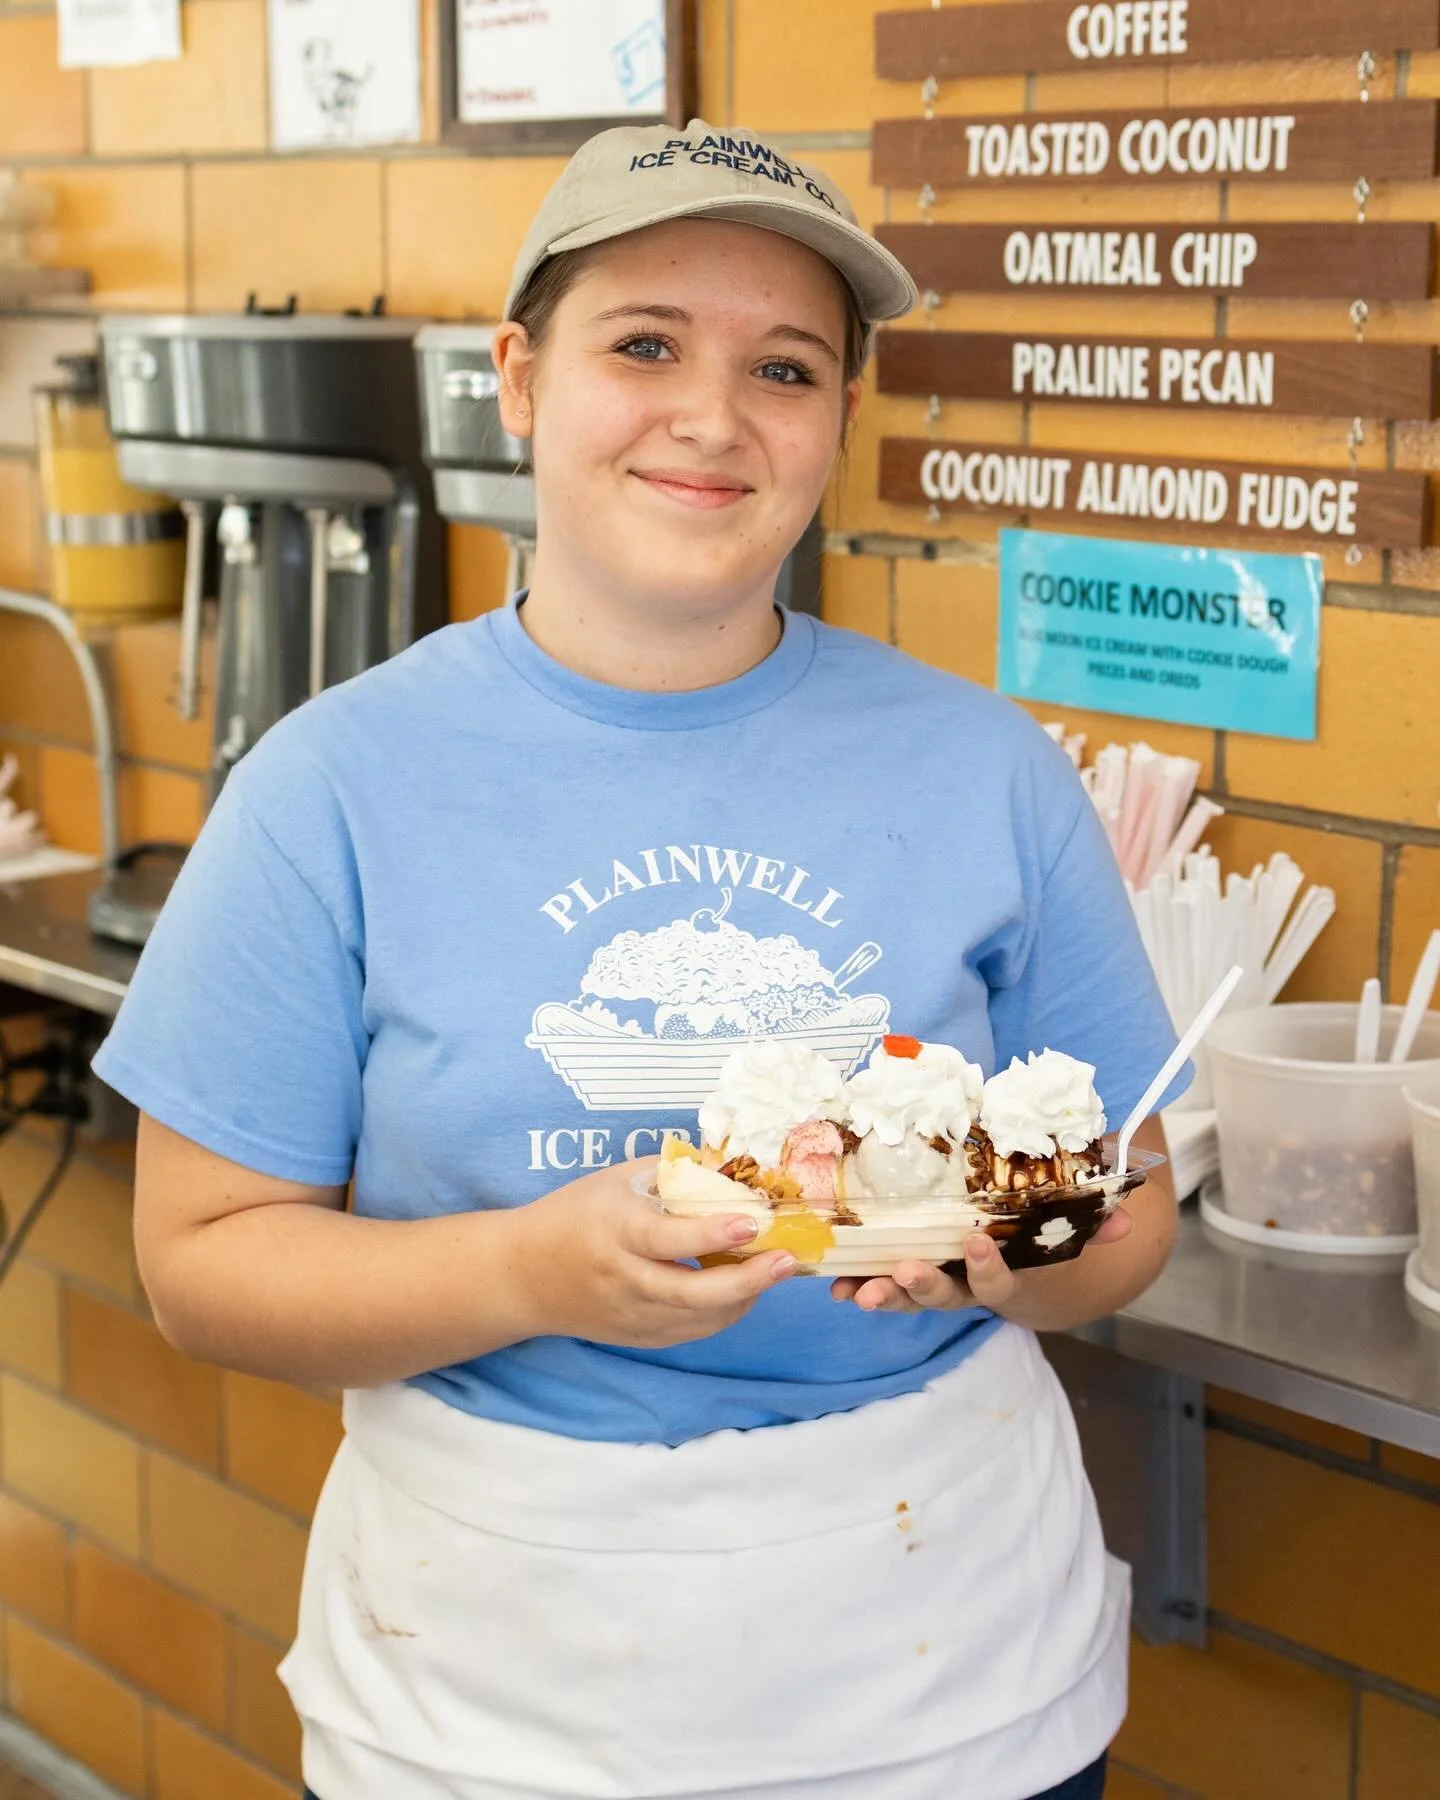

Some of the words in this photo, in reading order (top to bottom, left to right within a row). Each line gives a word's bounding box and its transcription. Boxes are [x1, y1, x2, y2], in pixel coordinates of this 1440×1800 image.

[1067, 0, 1188, 59] COFFEE
[629, 151, 677, 172] ICE
[690, 150, 796, 188] CREAM
[664, 135, 815, 183] PLAINWELL
[965, 121, 1110, 177] TOASTED
[1118, 115, 1296, 175] COCONUT
[1004, 231, 1162, 287] OATMEAL
[1171, 232, 1258, 288] CHIP
[1012, 342, 1150, 399] PRALINE
[1160, 348, 1275, 406] PECAN
[921, 449, 1072, 510] COCONUT
[1076, 462, 1229, 523] ALMOND
[1238, 473, 1359, 536] FUDGE
[1021, 571, 1122, 614] COOKIE
[1151, 643, 1186, 660] WITH
[1187, 647, 1234, 666] COOKIE
[1237, 655, 1289, 675] DOUGH
[538, 844, 845, 935] PLAINWELL
[527, 1128, 613, 1170] ICE
